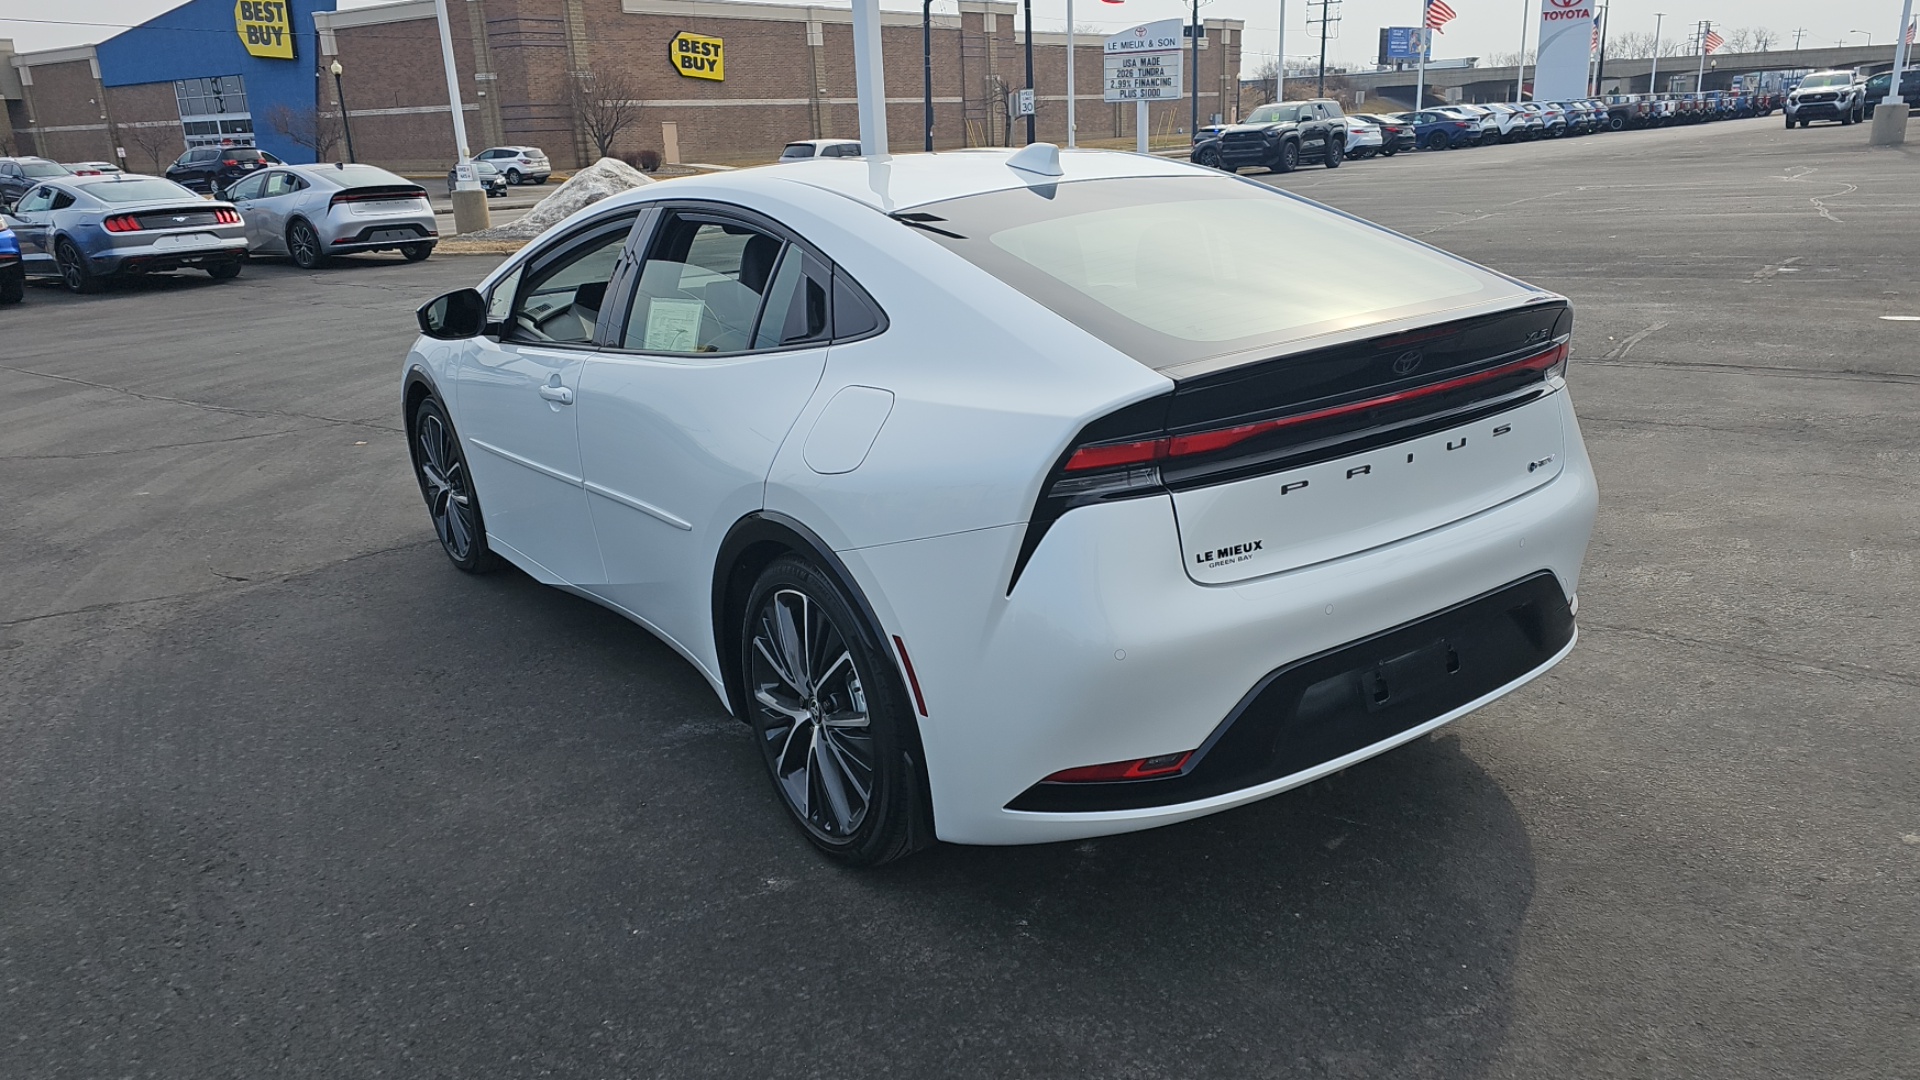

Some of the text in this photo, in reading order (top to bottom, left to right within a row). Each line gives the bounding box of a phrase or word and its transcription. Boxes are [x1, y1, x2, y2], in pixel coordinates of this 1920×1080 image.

[240, 1, 284, 23] BEST
[1543, 9, 1590, 21] TOYOTA
[246, 25, 283, 46] BUY
[678, 39, 721, 57] BEST
[1108, 38, 1176, 50] LE MIEUX & SON
[681, 55, 718, 72] BUY
[1123, 57, 1161, 68] USA MADE
[1116, 67, 1165, 78] 2026 TUNDRA
[1134, 77, 1172, 87] FINANCING
[1120, 90, 1137, 98] PLUS
[1022, 102, 1033, 112] 30
[1281, 423, 1512, 495] PRIUS
[1196, 540, 1263, 563] LE MIEUX
[1208, 554, 1254, 569] GREEN BAY
